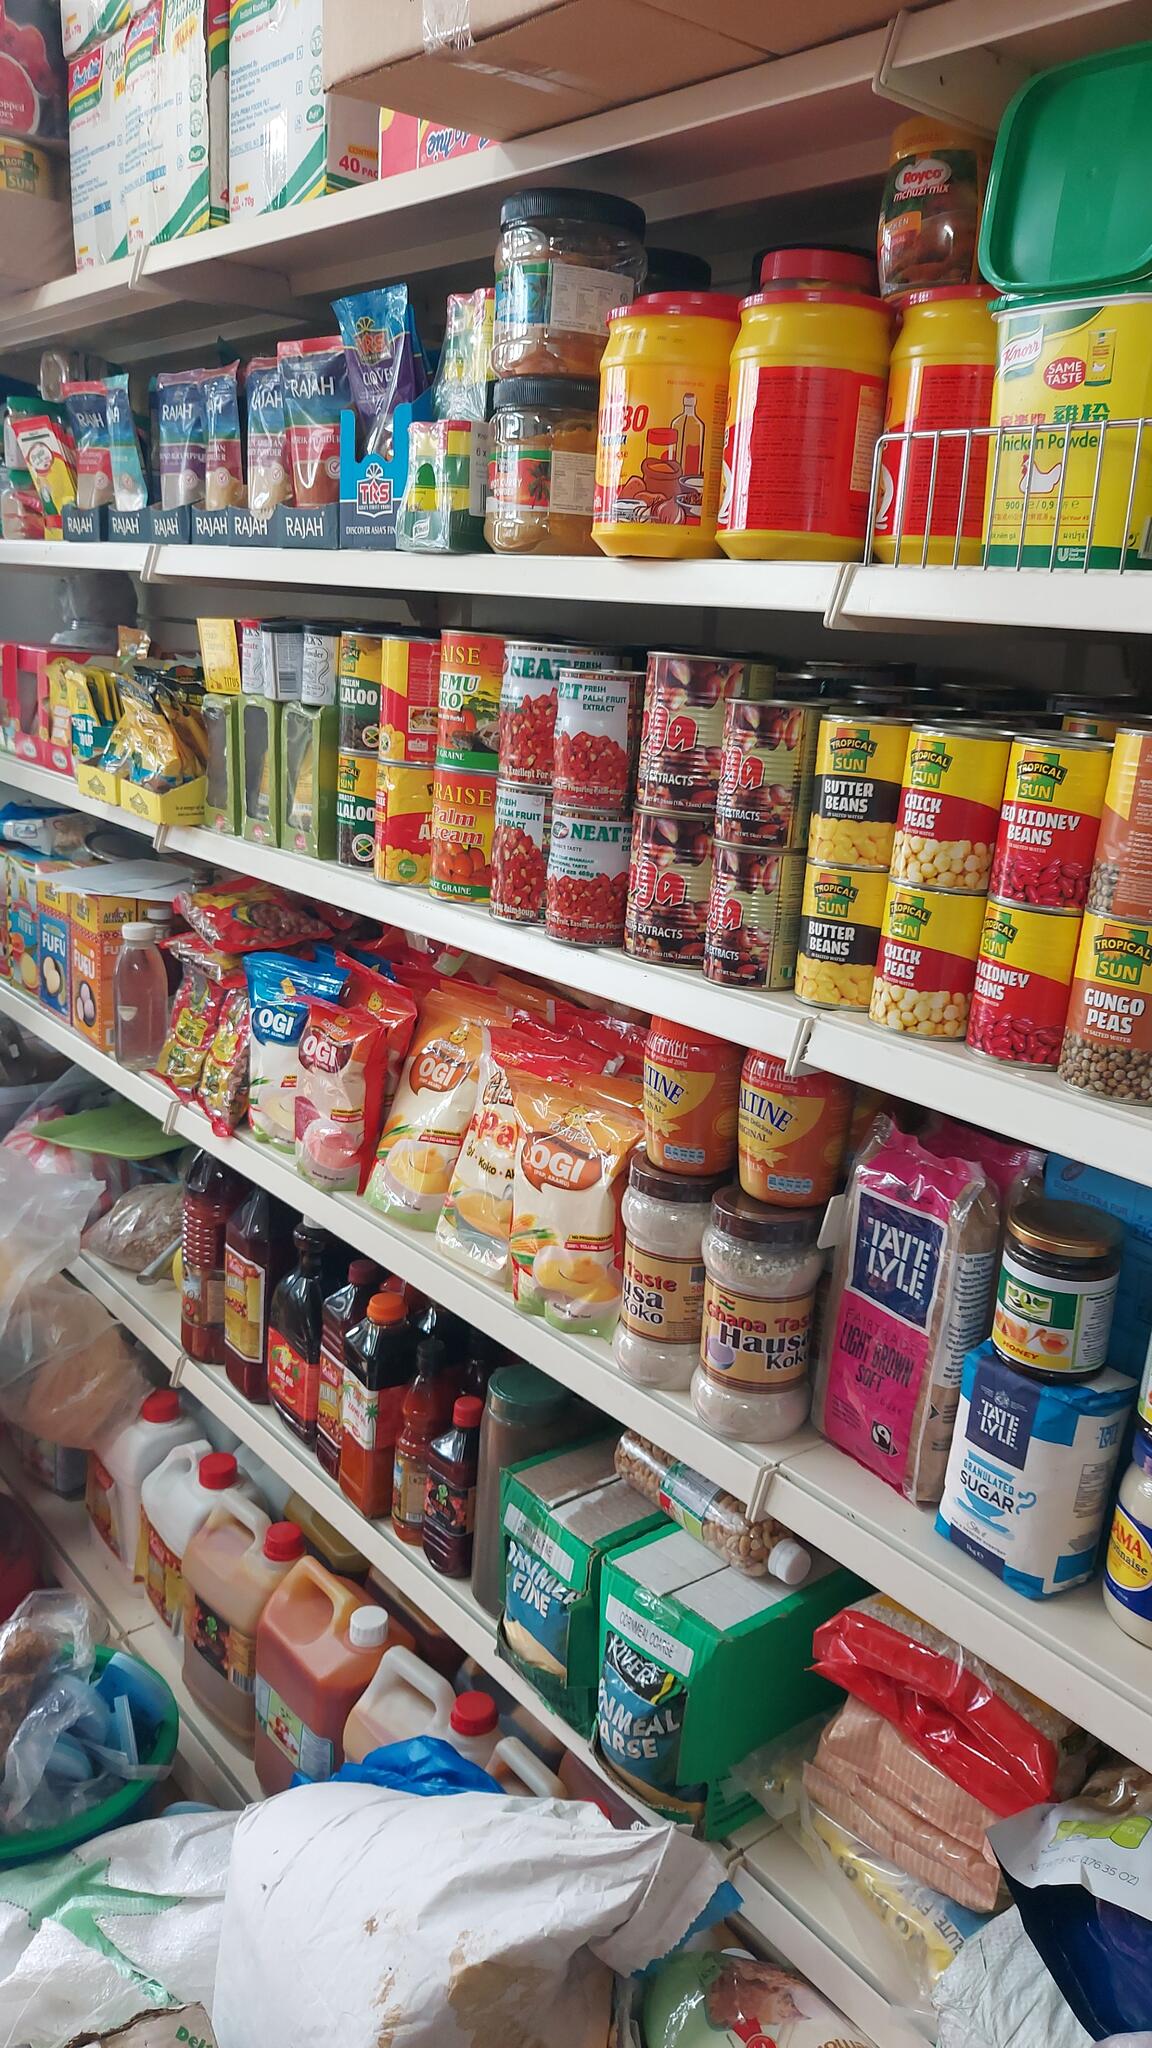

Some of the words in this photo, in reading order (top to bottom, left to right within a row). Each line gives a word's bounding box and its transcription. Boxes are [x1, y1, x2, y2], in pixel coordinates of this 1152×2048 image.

[339, 156, 361, 173] 40
[902, 169, 944, 185] Royco
[894, 187, 927, 202] mchuzi
[928, 183, 949, 195] mix
[1002, 339, 1041, 364] Knorr
[1048, 360, 1083, 375] SAME
[292, 376, 334, 399] RAJAH
[1047, 373, 1082, 385] TASTE
[162, 402, 193, 421] RAJAH
[1047, 430, 1101, 449] Powde
[359, 483, 389, 505] TRS
[1005, 500, 1020, 510] 900
[67, 516, 93, 535] RAJAH
[112, 515, 140, 535] RAJAH
[154, 516, 179, 536] RAJAH
[196, 515, 228, 536] RAJAH
[235, 516, 268, 536] RAJAH
[286, 517, 324, 537] RAJAH
[345, 526, 370, 536] DISCOVER
[510, 656, 571, 681] NEAT
[224, 676, 240, 688] TITUS
[584, 684, 607, 694] FRESH
[582, 694, 604, 704] PALM
[605, 695, 627, 704] FRUIT
[582, 704, 615, 713] EXTRACT
[830, 739, 873, 754] TROPICAL
[834, 757, 865, 771] SUN
[911, 750, 949, 768] TROPICAL
[649, 770, 694, 787] EXTRACTS
[912, 770, 938, 786] SUN
[1017, 761, 1063, 781] TROPICAL
[824, 779, 875, 798] BUTTER
[1020, 782, 1052, 800] SUN
[825, 795, 868, 814] BEANS
[904, 793, 943, 814] CHICK
[433, 804, 476, 829] Palm
[515, 811, 541, 821] FRUIT
[904, 810, 935, 831] PEAS
[1016, 807, 1081, 832] KIDNEY
[571, 822, 622, 843] NEAT
[1007, 826, 1053, 847] BEANS
[578, 870, 595, 879] 400g
[441, 883, 472, 896] GRAINE
[814, 883, 856, 900] TROPICAL
[817, 900, 847, 916] SUN
[890, 902, 928, 921] TROPICAL
[636, 923, 683, 940] EXTRACTS
[808, 920, 857, 942] BUTTER
[891, 921, 918, 939] SUN
[42, 930, 66, 958] FUFU
[809, 936, 850, 957] BEANS
[884, 941, 922, 966] CHICK
[983, 938, 1005, 957] SUN
[1094, 938, 1152, 961] TROPICAL
[74, 948, 95, 980] FUFU
[884, 958, 915, 980] PEAS
[1098, 959, 1138, 982] SUN
[979, 961, 1030, 989] KIDNEY
[1084, 987, 1146, 1017] GUNGO
[258, 1007, 296, 1036] OGI
[1086, 1008, 1134, 1034] PEAS
[1089, 1030, 1109, 1039] SALTED
[1110, 1034, 1132, 1044] WATER
[303, 1034, 338, 1068] OGI
[419, 1057, 456, 1088] OGI
[478, 1155, 497, 1176] Koko
[530, 1143, 586, 1184] OGI
[867, 1216, 932, 1272] TATE
[626, 1260, 678, 1293] Taste
[867, 1246, 928, 1301] LYLE
[624, 1296, 664, 1326] Koko
[707, 1298, 767, 1334] Ghana
[840, 1320, 873, 1362] LIGHT
[871, 1341, 915, 1389] BROWN
[1002, 1339, 1041, 1361] HONEY
[855, 1363, 884, 1393] SOFT
[980, 1397, 1020, 1432] TATE
[979, 1420, 1018, 1450] LYLE
[963, 1457, 1015, 1496] GRANULATED
[959, 1468, 1015, 1514] SUGAR
[512, 1571, 551, 1618] FINE
[619, 1610, 648, 1642] CORNMEAL
[649, 1631, 675, 1659] COARSE
[1118, 1871, 1140, 1887] OZ)
